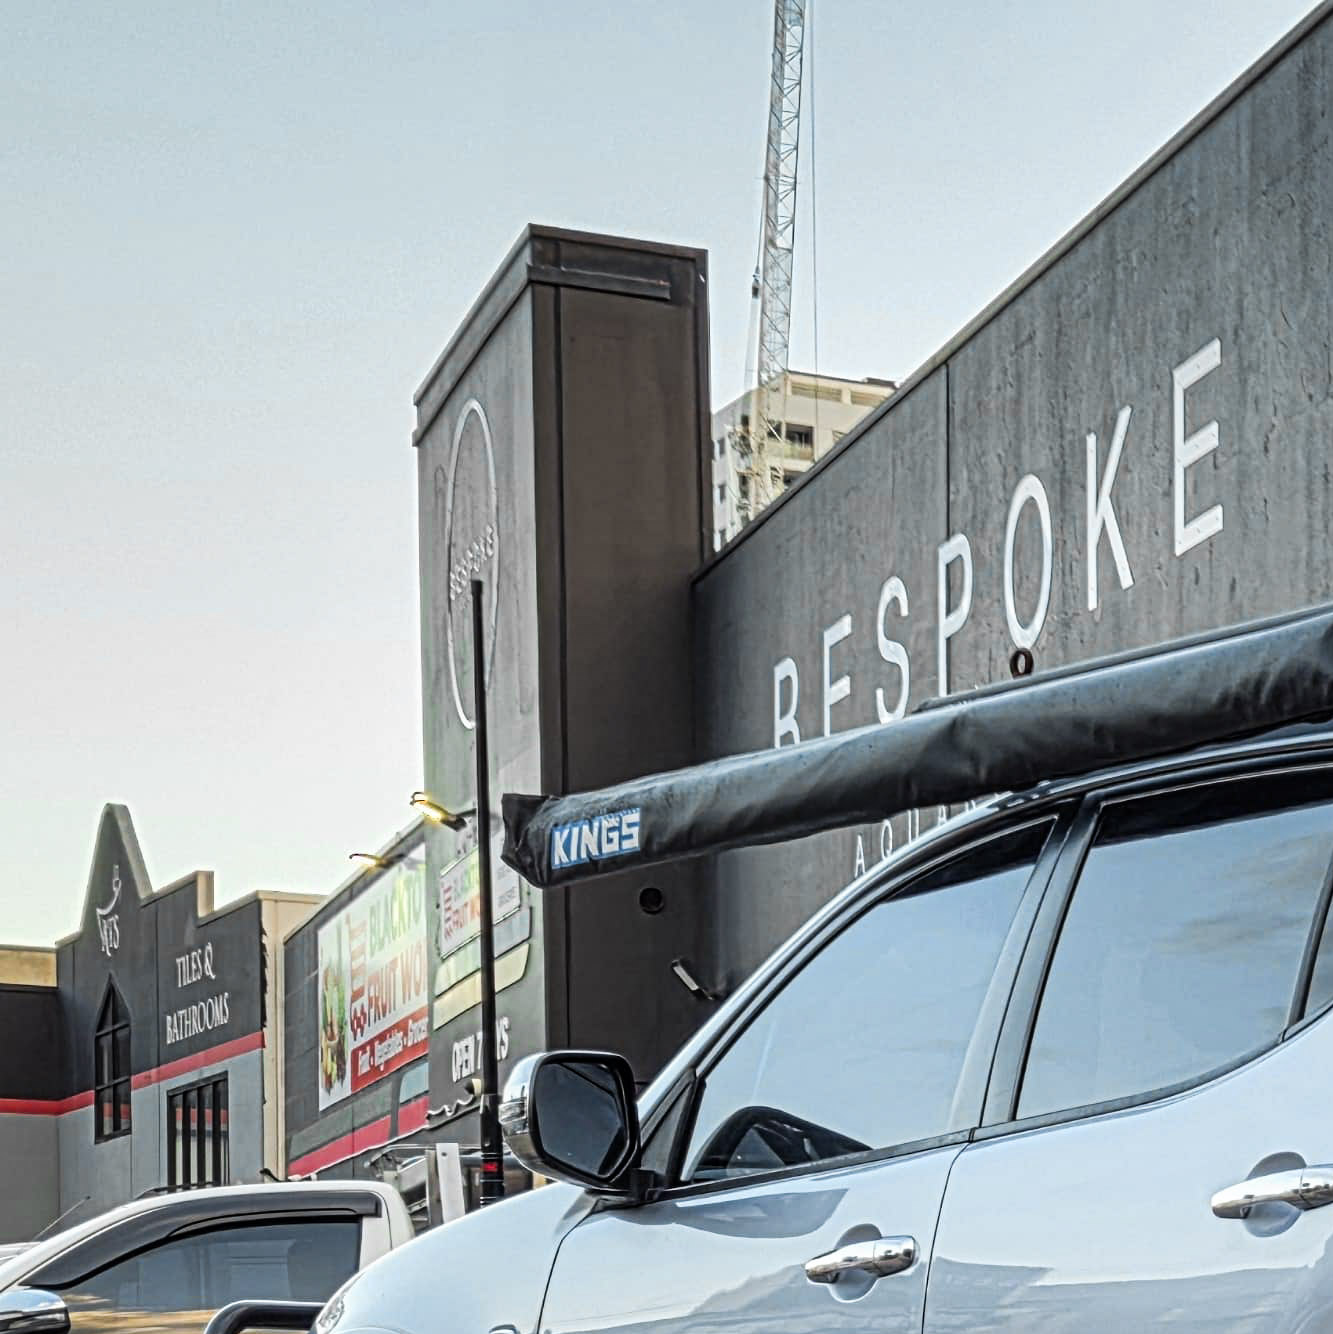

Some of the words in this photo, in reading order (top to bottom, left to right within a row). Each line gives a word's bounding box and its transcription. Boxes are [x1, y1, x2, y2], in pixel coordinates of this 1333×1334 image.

[774, 338, 1223, 748] BESPOKE
[553, 811, 640, 867] KINGS
[176, 950, 203, 988] TILES
[205, 942, 216, 979] &
[367, 955, 400, 1026] FRUIT
[166, 992, 230, 1045] BATHROOMS
[452, 1034, 475, 1083] OPEN
